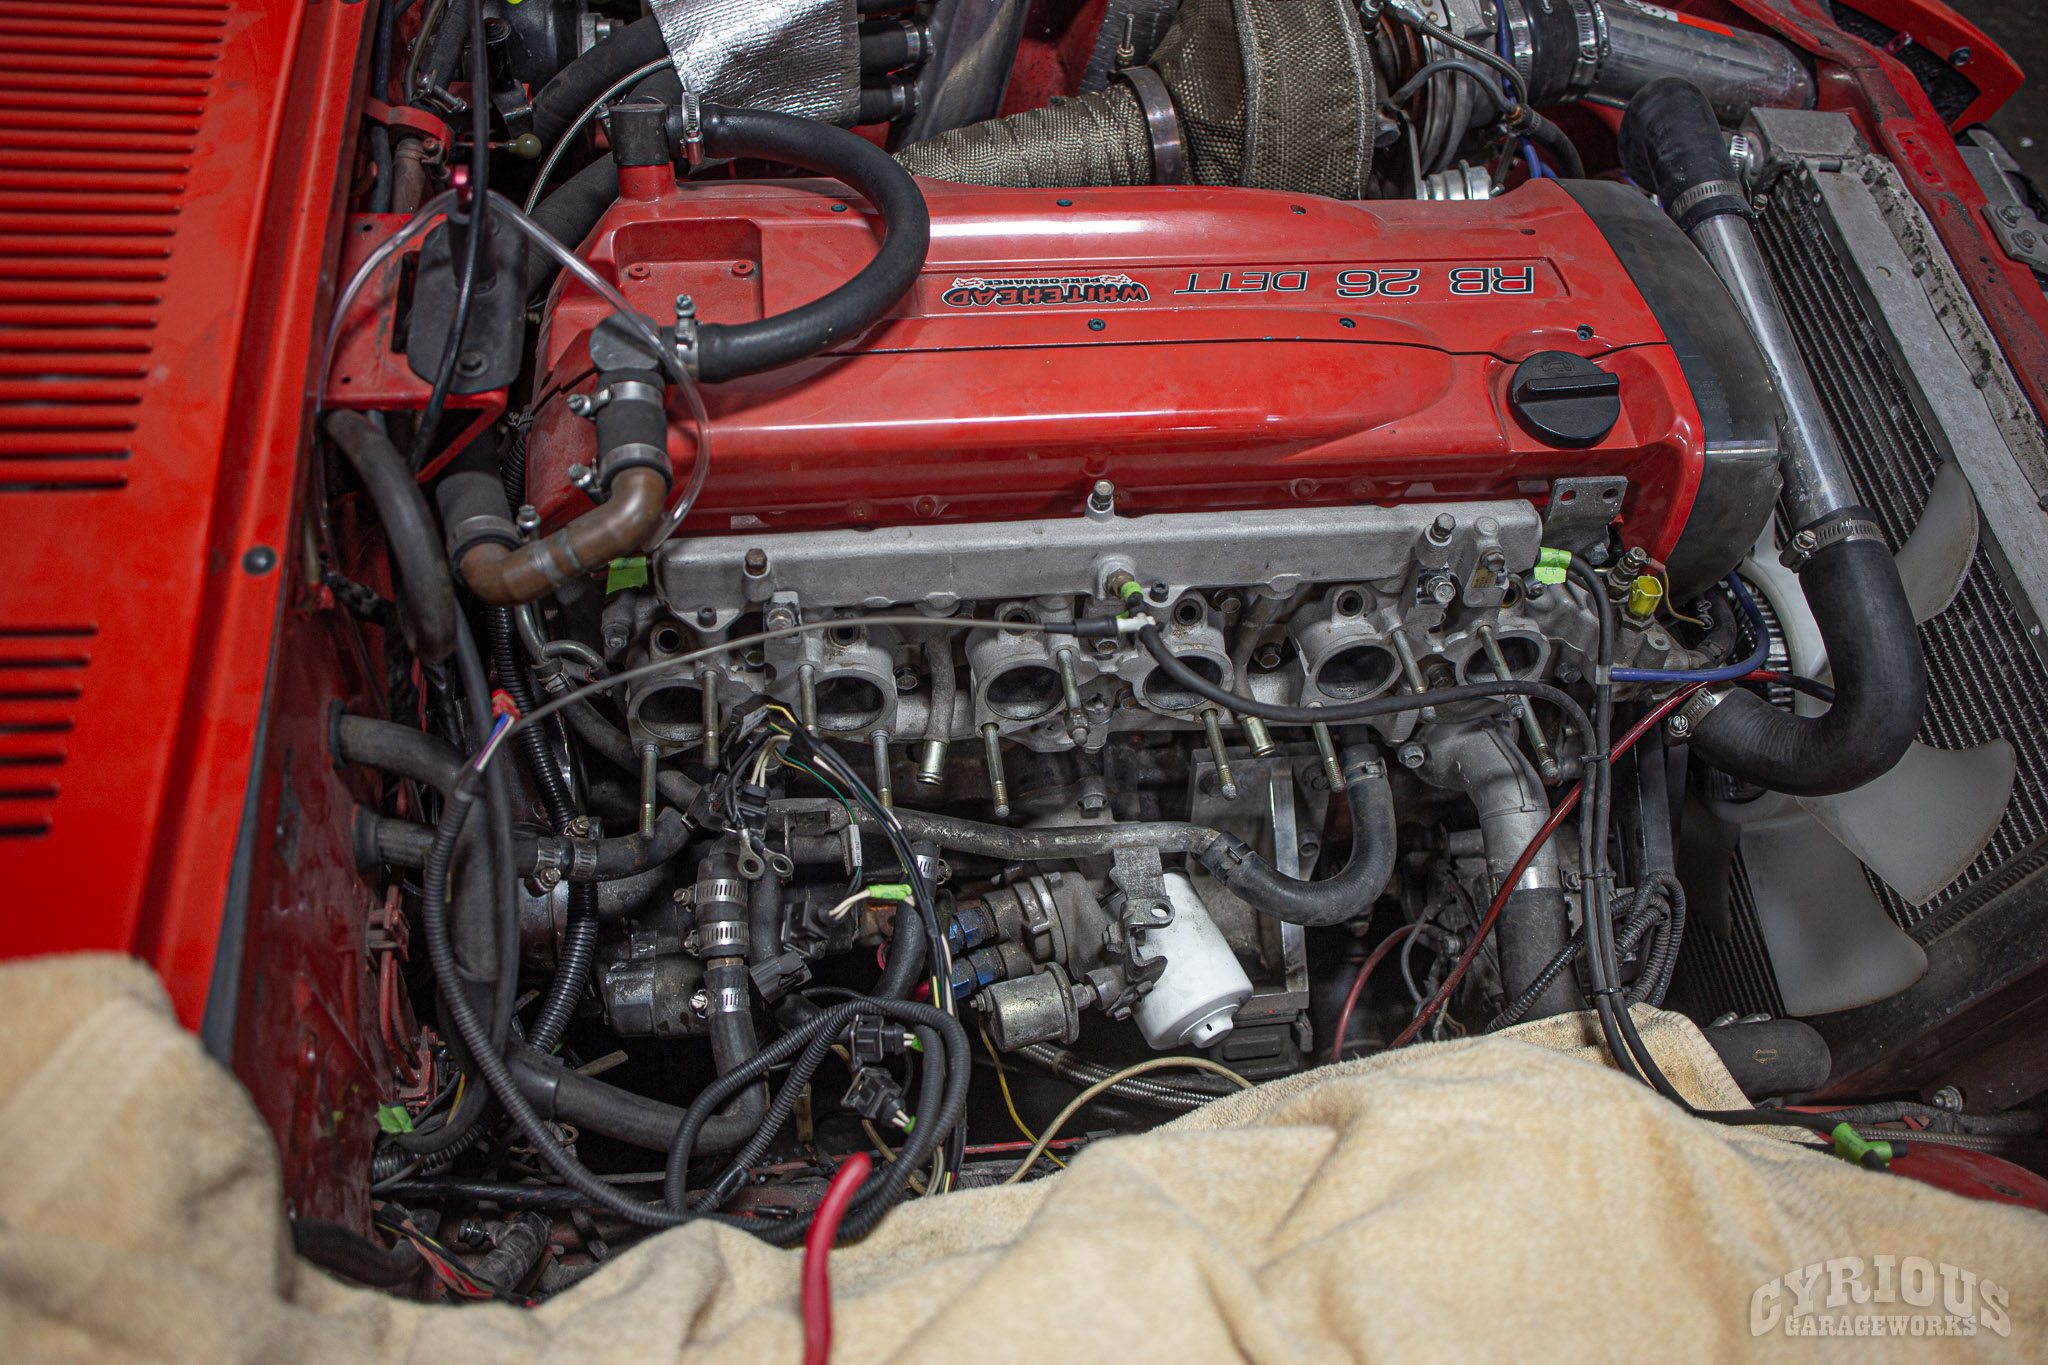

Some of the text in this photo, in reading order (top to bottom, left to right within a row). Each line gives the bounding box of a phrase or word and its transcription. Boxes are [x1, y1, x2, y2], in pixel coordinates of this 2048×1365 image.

[984, 276, 1100, 286] PERFORMANCE
[1173, 266, 1534, 298] RB 26 DETT
[942, 283, 1150, 307] WHITEHEAD
